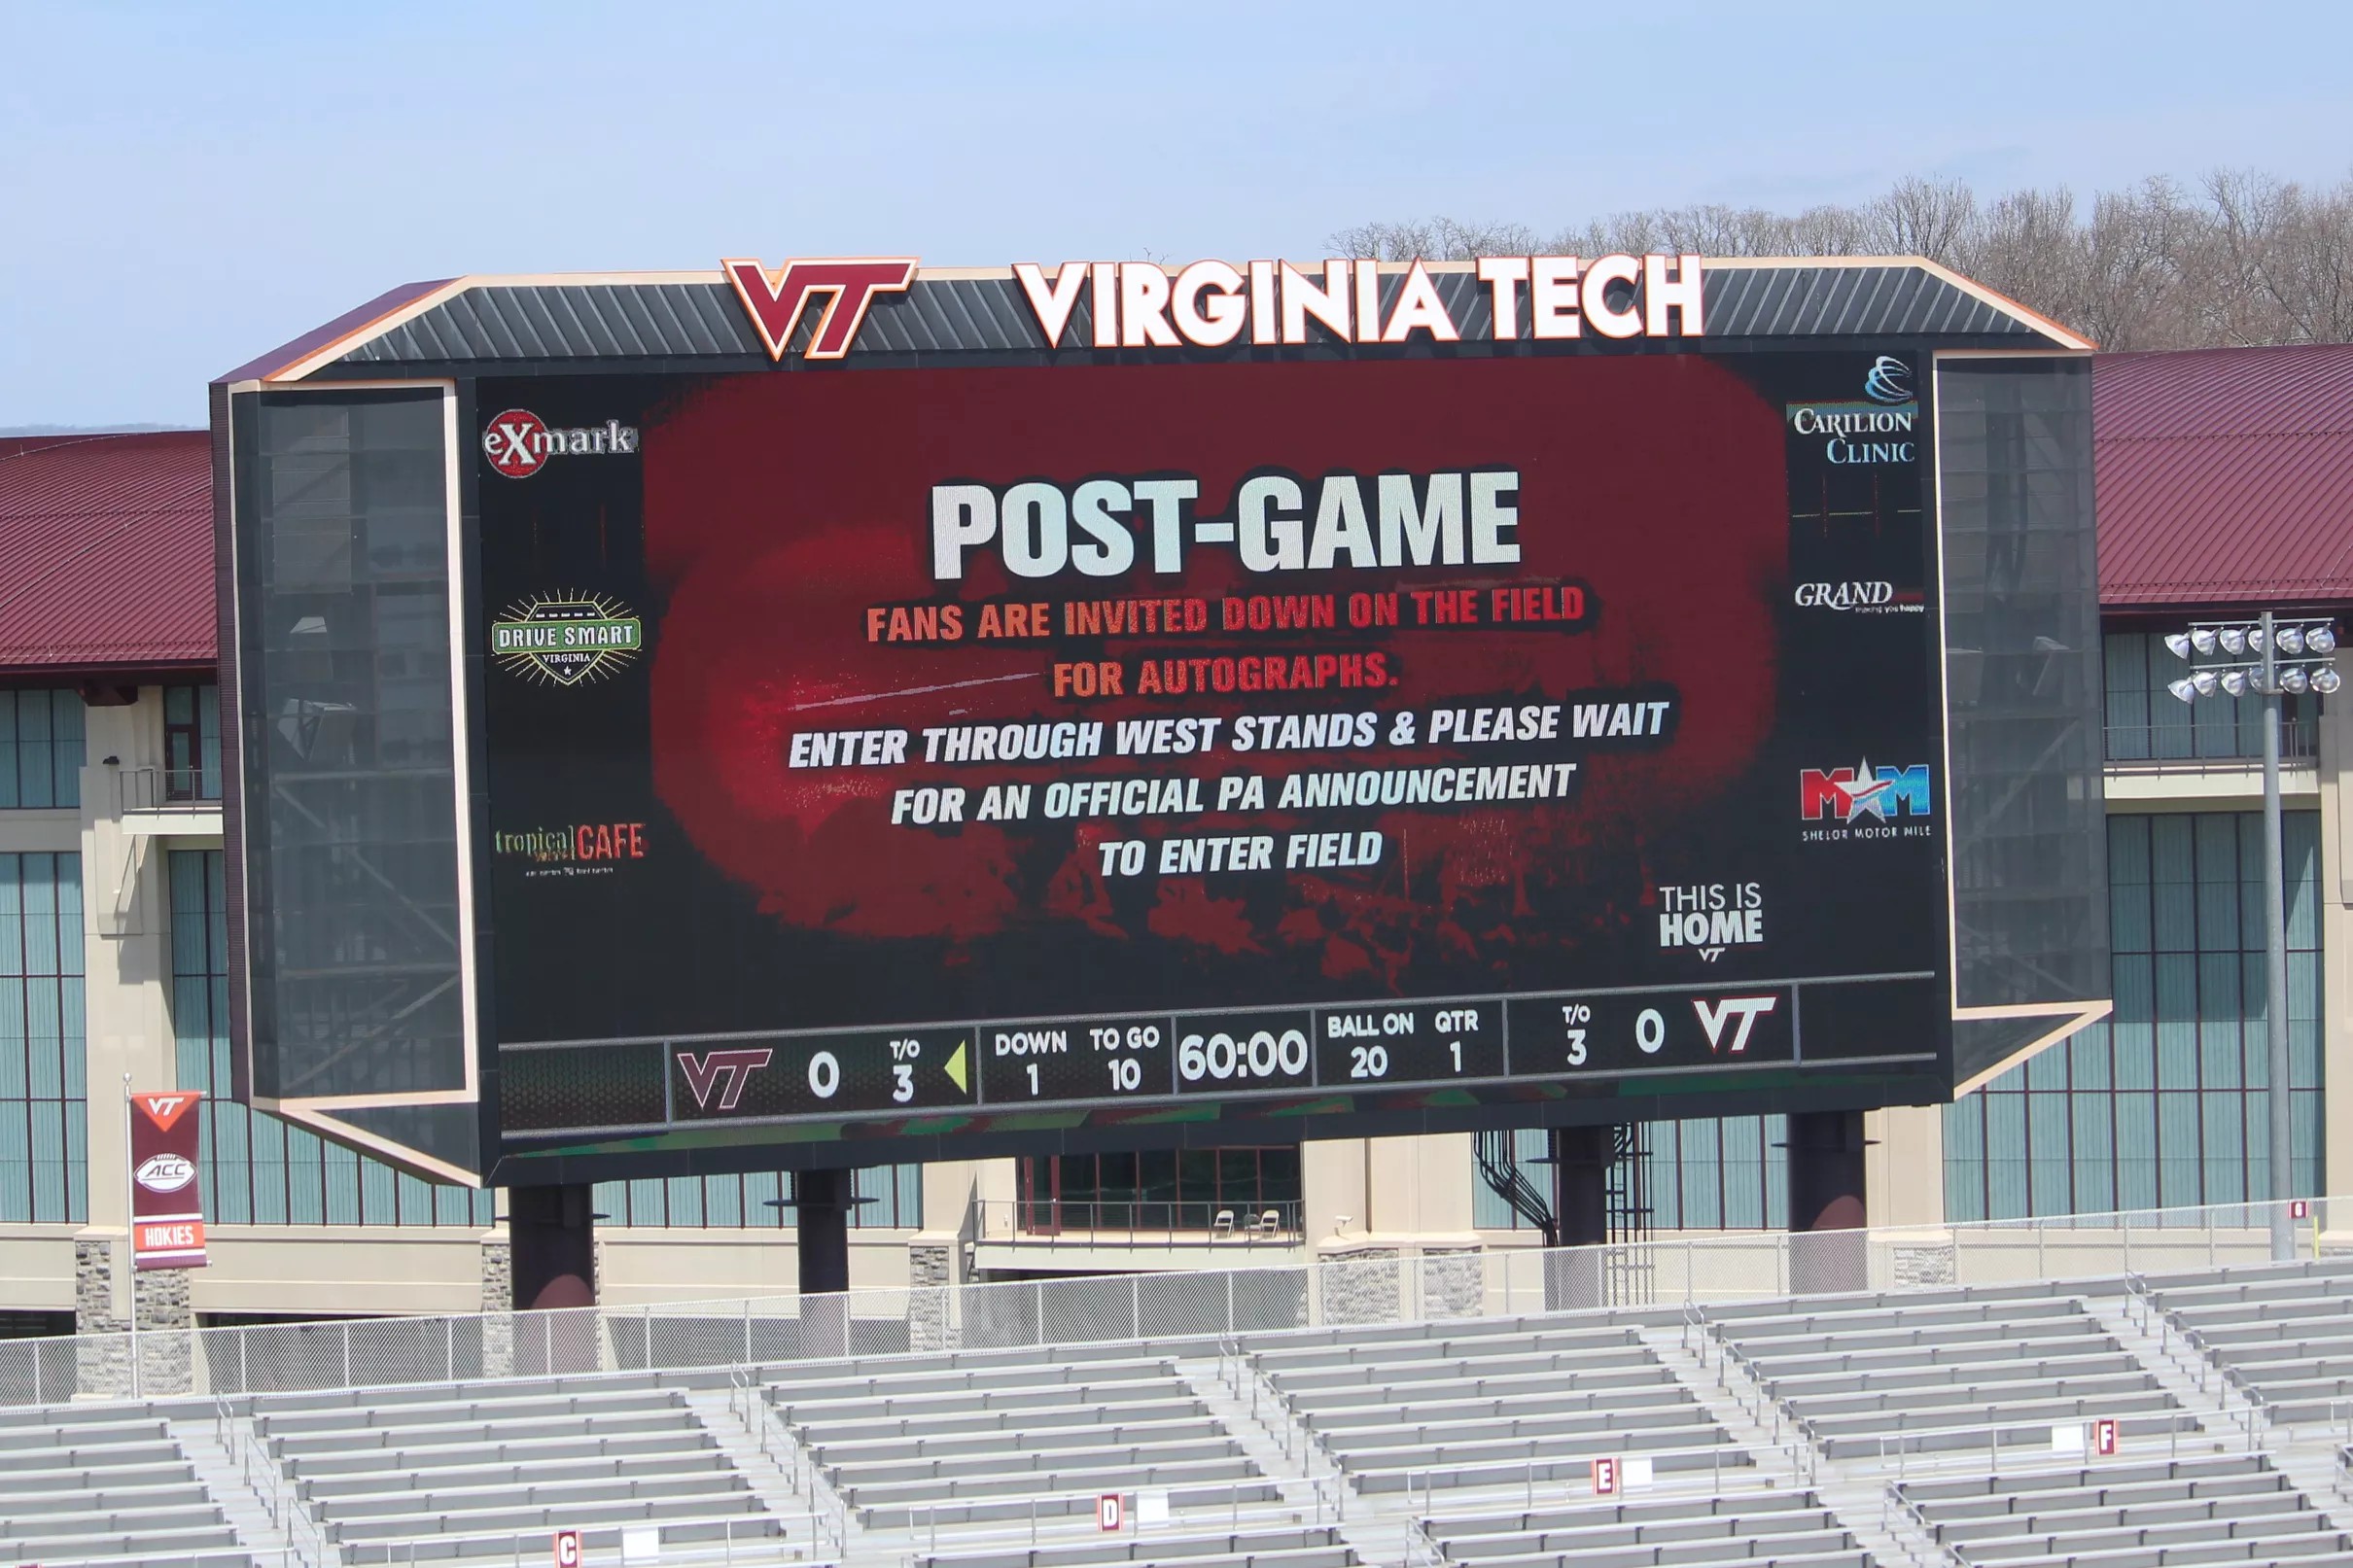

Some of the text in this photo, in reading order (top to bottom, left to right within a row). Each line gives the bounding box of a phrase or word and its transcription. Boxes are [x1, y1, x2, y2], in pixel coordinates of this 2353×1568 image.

[720, 257, 921, 362] VT
[1011, 253, 1704, 349] VIRGINIA TECH
[1794, 407, 1912, 437] CARILION
[483, 420, 638, 466] eXmark
[1826, 437, 1915, 464] CLINIC
[932, 471, 1521, 579] POST-GAME
[1795, 581, 1893, 610] GRAND
[867, 586, 1584, 642] FANS ARE INVITED DOWN ON THE FIELD
[499, 625, 633, 647] DRIVE SMART
[543, 653, 591, 663] VIRGINIA
[1053, 652, 1399, 697] FOR AUTOGRAPHS.
[789, 701, 1669, 768] ENTER THROUGH WEST STANDS & PLEASE WAIT
[892, 762, 1577, 825] FOR AN OFFICIAL PA ANNOUNCEMENT
[577, 823, 645, 860] CAFE
[1802, 825, 1931, 842] SHELOR MOTOR MILE
[1098, 831, 1383, 877] TO ENTER FIELD
[1659, 882, 1762, 912] THIS IS
[1659, 909, 1764, 947] HOME
[1699, 947, 1726, 962] VT
[1327, 1012, 1414, 1038] BALL ON
[1434, 1009, 1479, 1033] QTR
[1562, 1003, 1591, 1026] T/O
[1692, 994, 1778, 1055] VT
[995, 1030, 1068, 1057] DOWN
[1089, 1026, 1160, 1051] TO GO
[1566, 1028, 1587, 1065] 3
[1635, 1008, 1666, 1054] 0
[889, 1038, 920, 1061] T/O
[1178, 1029, 1308, 1081] 60:00
[1351, 1045, 1388, 1078] 20
[1450, 1041, 1461, 1072] 1
[677, 1048, 773, 1110] VT
[808, 1051, 840, 1098] 0
[893, 1064, 914, 1102] 3
[1026, 1063, 1038, 1096] 1
[1108, 1058, 1141, 1091] 10
[148, 1097, 185, 1116] VT
[146, 1164, 187, 1177] ACC
[145, 1226, 194, 1246] HOKIES
[2100, 1424, 2112, 1450] F
[1598, 1462, 1611, 1489] E
[1103, 1498, 1118, 1527] D
[559, 1535, 576, 1565] C
